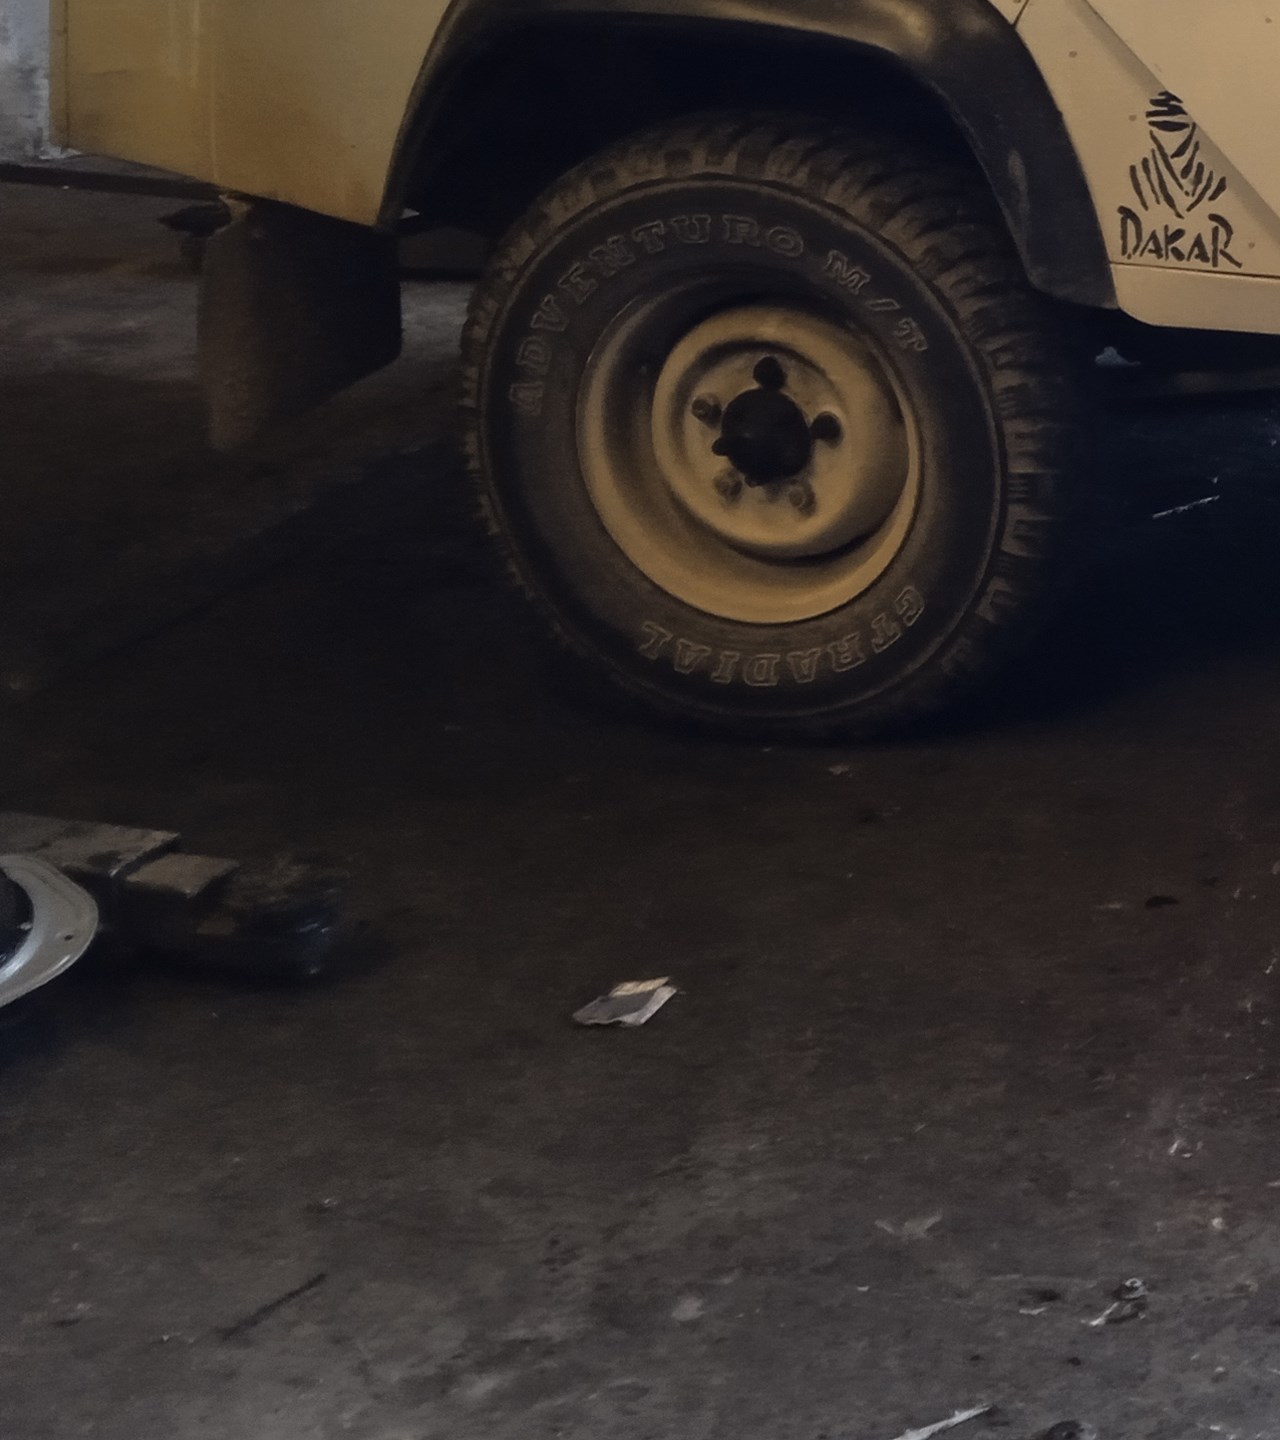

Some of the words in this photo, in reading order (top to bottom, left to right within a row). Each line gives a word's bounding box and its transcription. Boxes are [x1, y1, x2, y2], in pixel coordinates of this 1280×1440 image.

[1117, 205, 1243, 268] DAKAR
[508, 214, 804, 416] ADVENTURO
[823, 249, 929, 351] M/T
